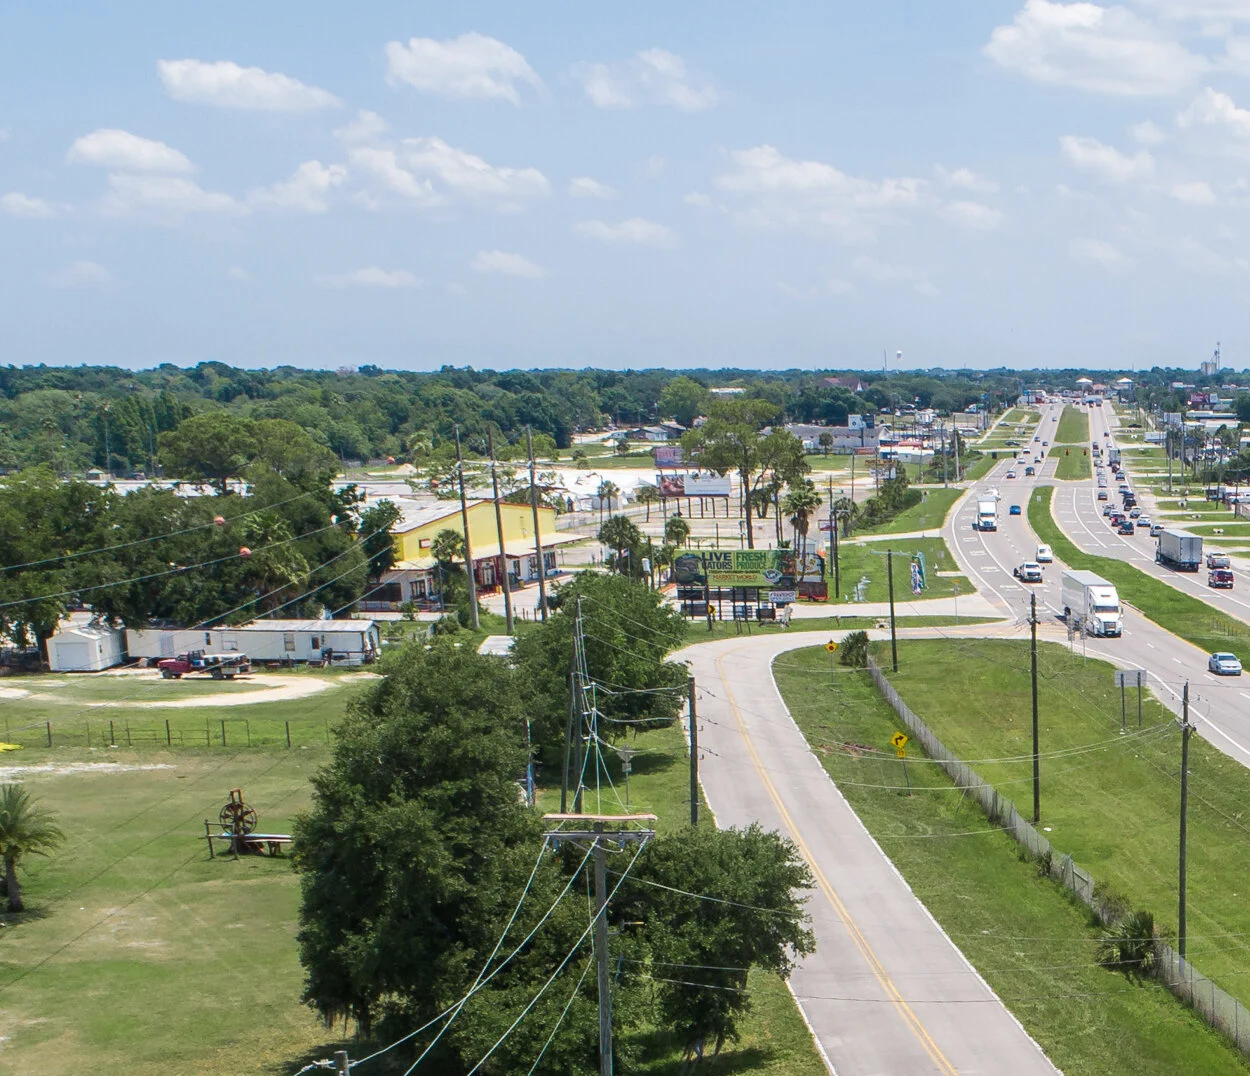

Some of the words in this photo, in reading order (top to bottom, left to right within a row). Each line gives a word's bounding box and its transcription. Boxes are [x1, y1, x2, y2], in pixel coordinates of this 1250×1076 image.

[702, 551, 732, 561] LIVE
[736, 551, 767, 561] FRESH
[736, 561, 767, 570] PRODUCE
